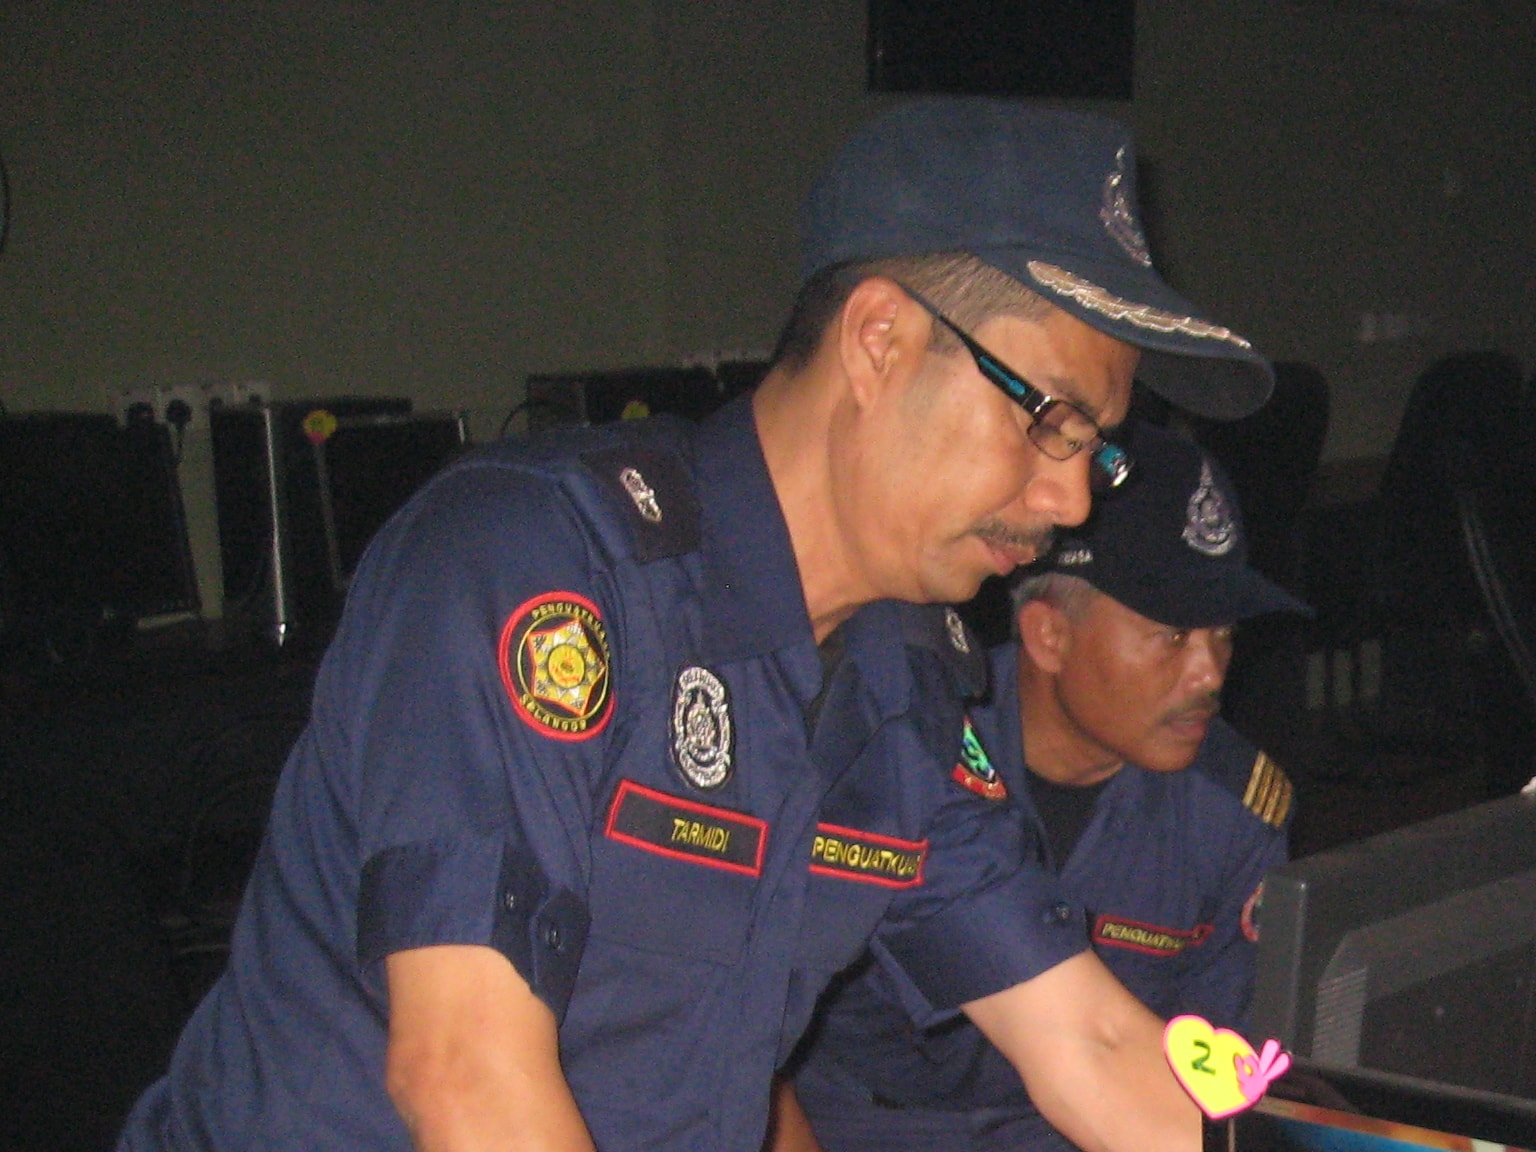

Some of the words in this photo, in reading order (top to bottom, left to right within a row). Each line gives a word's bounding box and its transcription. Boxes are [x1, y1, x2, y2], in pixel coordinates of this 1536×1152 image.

[519, 693, 587, 733] SELANGOR
[671, 818, 730, 853] TARMIDI
[1191, 1039, 1216, 1076] 2
